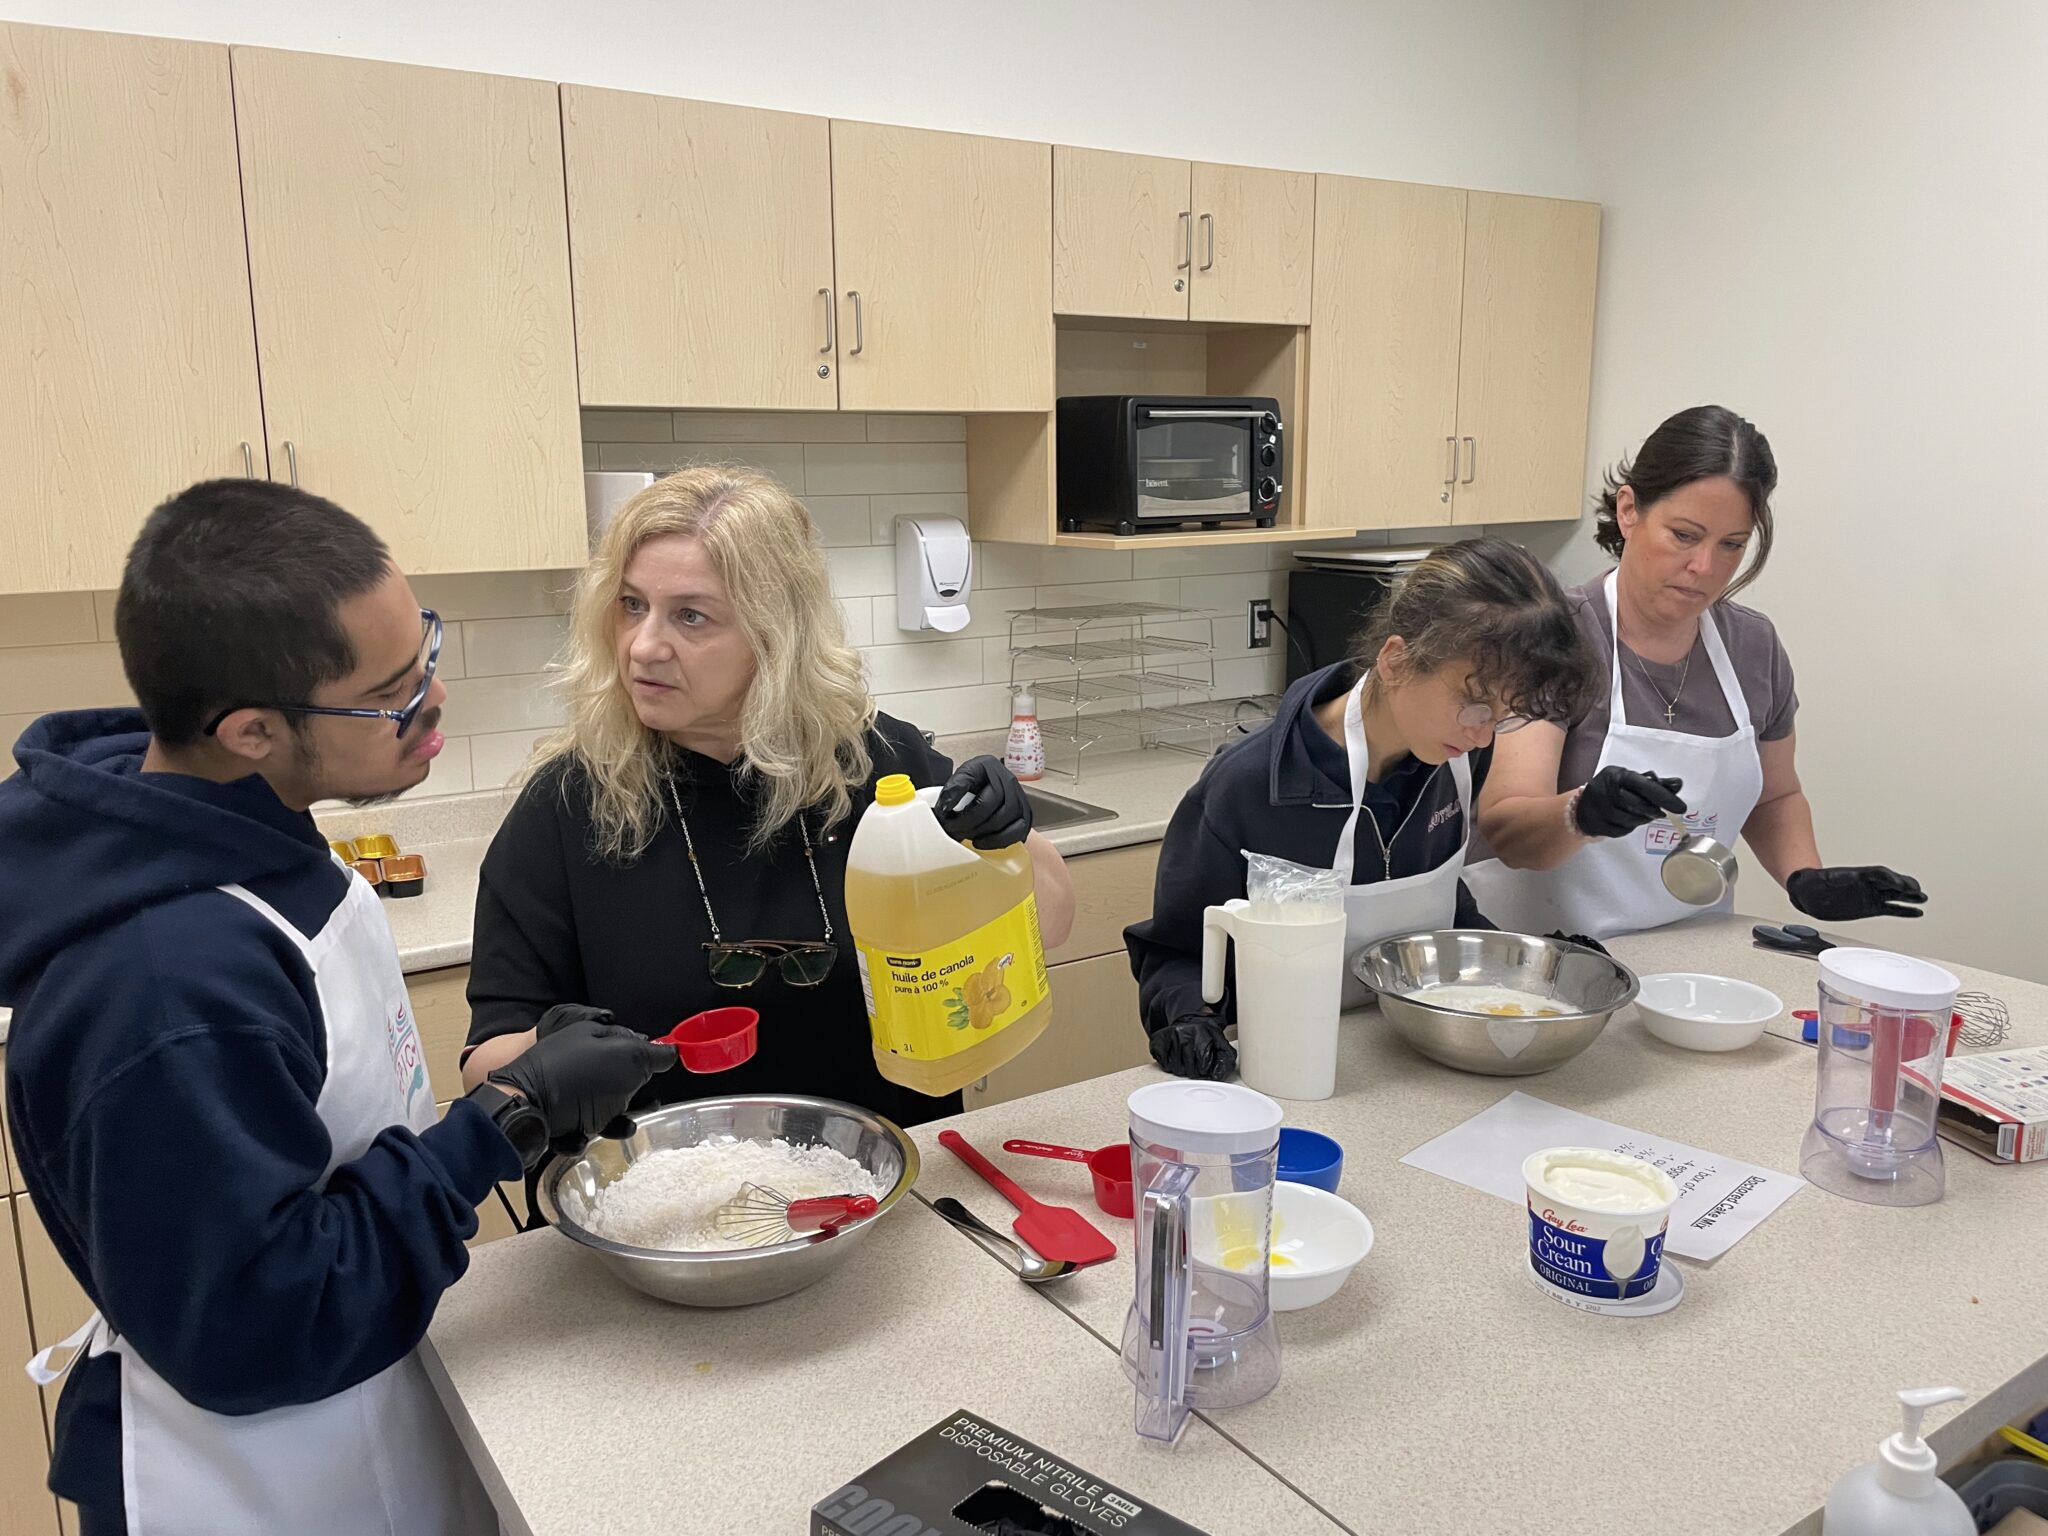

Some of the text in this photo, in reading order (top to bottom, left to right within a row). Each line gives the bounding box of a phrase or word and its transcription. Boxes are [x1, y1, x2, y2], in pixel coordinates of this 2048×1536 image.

[892, 955, 975, 983] huile de canola
[894, 977, 949, 994] pure à 100 %
[904, 1043, 915, 1053] 3 L
[1690, 1171, 1712, 1184] box
[1692, 1175, 1767, 1230] Doctored Cake Mix
[1542, 1209, 1586, 1232] Gay Lea
[1543, 1225, 1587, 1256] Sour
[1537, 1238, 1592, 1275] Cream
[1540, 1263, 1592, 1293] ORIGINAL
[953, 1417, 1103, 1496] PREMIUM NITRILE
[939, 1426, 1128, 1527] DISPOSABLE GLOVES
